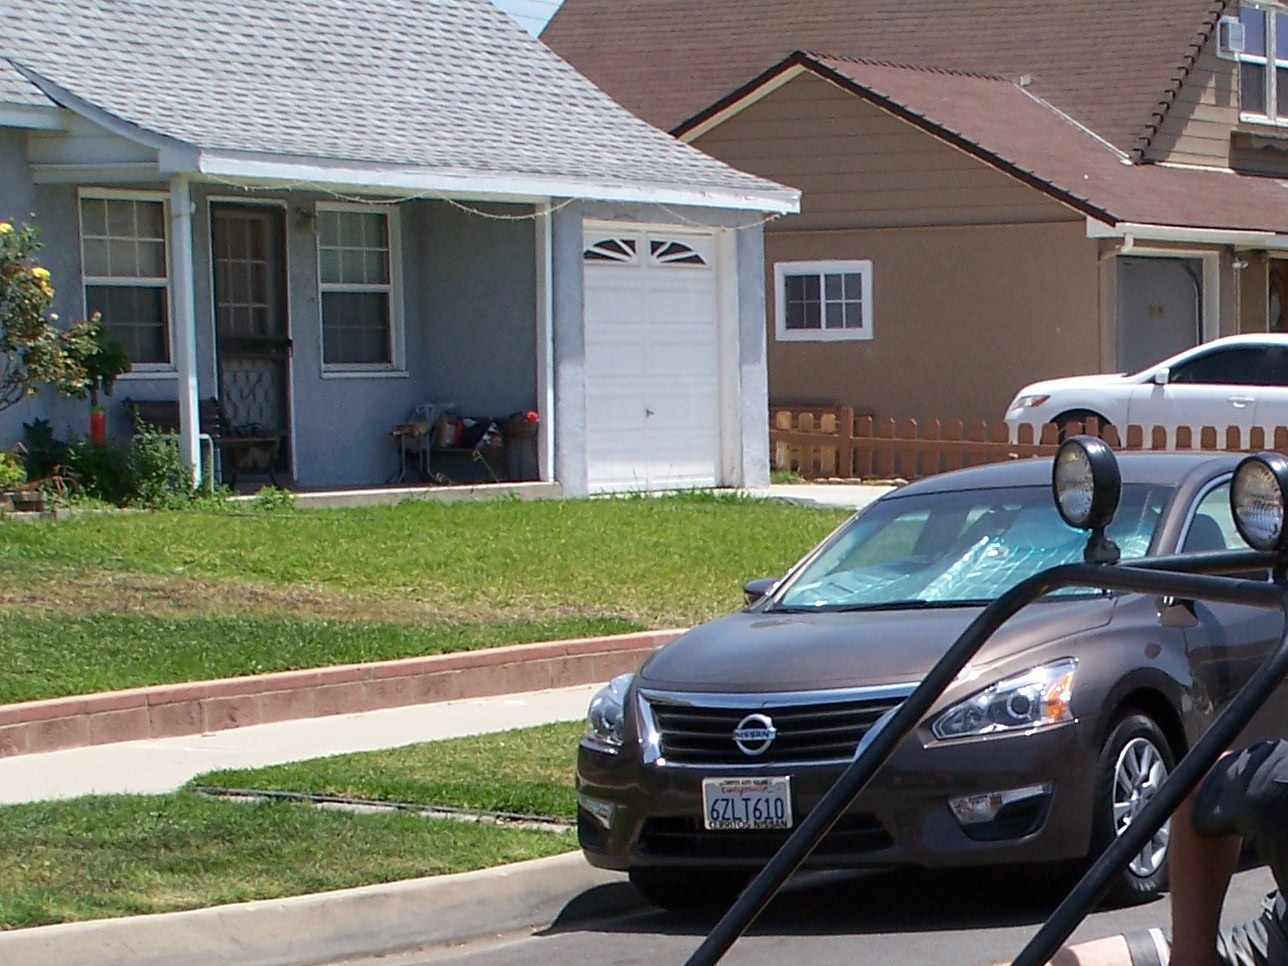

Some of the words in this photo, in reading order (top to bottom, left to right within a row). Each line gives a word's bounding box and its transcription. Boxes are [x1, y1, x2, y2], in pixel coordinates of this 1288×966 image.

[734, 730, 770, 738] NISSAN
[710, 797, 784, 821] 6ZLT610
[753, 820, 788, 829] NISSAN
